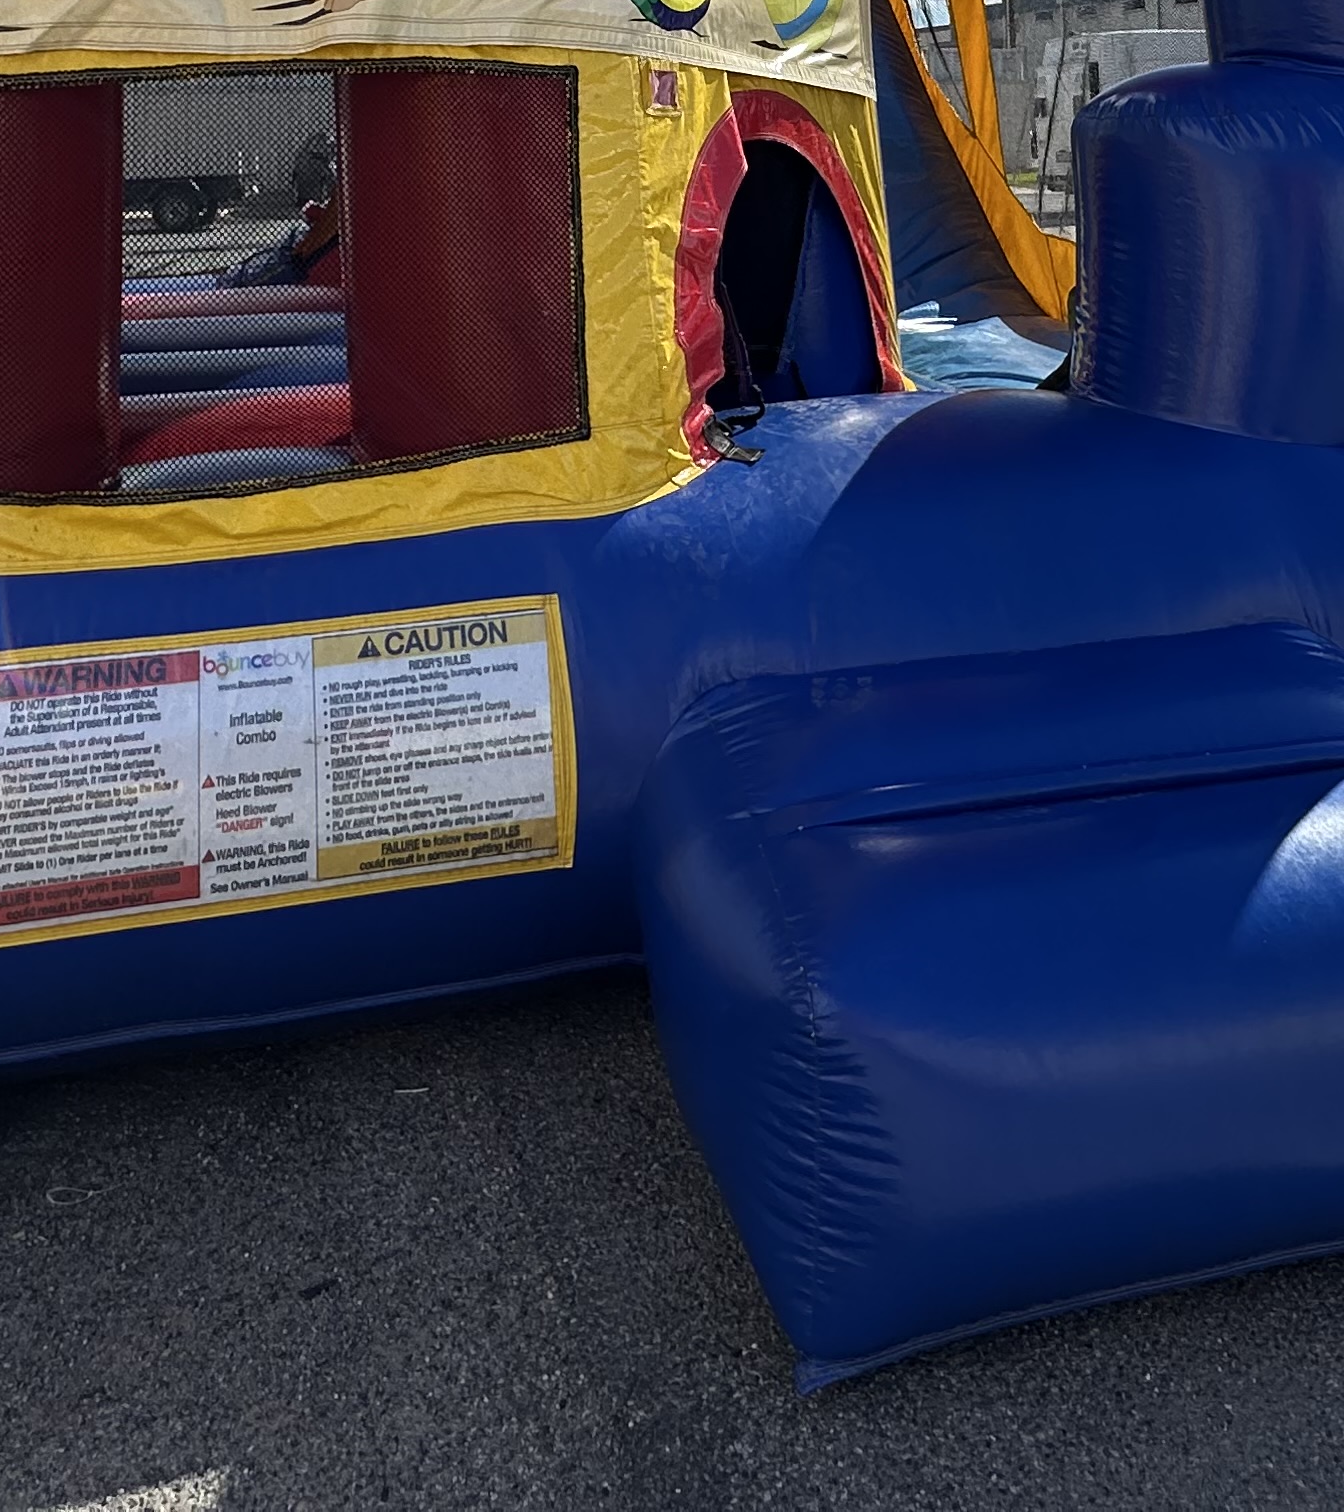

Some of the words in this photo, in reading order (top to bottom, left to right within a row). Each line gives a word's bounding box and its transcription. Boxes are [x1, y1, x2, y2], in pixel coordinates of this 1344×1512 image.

[384, 619, 508, 656] CAUTION
[203, 649, 310, 677] bouncebuy
[408, 656, 443, 671] RIDER'S
[444, 653, 471, 666] RULES
[23, 657, 166, 696] WARNING
[10, 700, 24, 712] DO
[27, 698, 46, 710] NOT
[47, 696, 81, 710] operate
[83, 693, 100, 705] this
[101, 691, 122, 703] Ride
[124, 687, 158, 700] without
[330, 693, 354, 706] NEVER
[373, 689, 387, 699] and
[388, 687, 404, 697] dive
[420, 684, 432, 694] the
[434, 682, 448, 692] ride
[4, 726, 29, 738] Adult
[30, 720, 75, 735] Attendant
[77, 716, 111, 732] present
[113, 715, 122, 726] at
[124, 713, 134, 725] all
[136, 711, 161, 723] times
[10, 713, 25, 724] the
[27, 707, 80, 725] Supervision
[82, 705, 91, 717] of
[93, 705, 99, 715] a
[230, 708, 283, 728] Inflatable
[236, 729, 277, 745] Combo
[2, 773, 17, 784] The
[89, 764, 102, 774] the
[104, 762, 121, 772] Ride
[216, 775, 236, 787] This
[238, 772, 260, 785] Ride
[262, 768, 302, 782] requires
[4, 799, 21, 810] NOT
[23, 797, 45, 808] allow
[47, 794, 73, 807] people
[75, 793, 84, 802] or
[86, 789, 111, 800] Riders
[113, 788, 121, 797] to
[123, 786, 137, 796] Use
[139, 784, 152, 794] the
[154, 781, 171, 792] Ride
[216, 786, 252, 802] electric
[253, 783, 293, 797] Blowers
[332, 793, 354, 806] SLIDE
[356, 790, 379, 803] DOWN
[381, 788, 395, 798] feet
[396, 786, 411, 796] first
[413, 783, 428, 794] only
[379, 803, 388, 812] up
[390, 800, 402, 810] the
[403, 797, 421, 808] slide
[447, 793, 463, 802] way
[9, 807, 52, 820] consumed
[54, 802, 83, 814] alcohol
[84, 803, 93, 811] or
[115, 796, 138, 807] drugs
[14, 820, 46, 833] RIDER'S
[48, 821, 58, 831] by
[60, 815, 107, 828] comparable
[109, 810, 136, 822] weight
[138, 807, 153, 818] and
[216, 805, 241, 820] Heed
[243, 803, 277, 817] Blower
[270, 812, 294, 828] sign!
[19, 834, 48, 846] exceed
[49, 833, 62, 842] the
[64, 828, 105, 840] Maximum
[107, 824, 138, 835] number
[139, 821, 148, 831] of
[149, 818, 175, 829] Riders
[176, 818, 185, 827] or
[381, 838, 420, 856] FAILURE
[422, 838, 431, 848] to
[433, 835, 462, 847] follow
[463, 831, 488, 842] these
[490, 824, 521, 841] RULES
[14, 861, 34, 872] Slide
[36, 859, 44, 869] to
[46, 857, 57, 870] (1)
[58, 856, 75, 866] One
[77, 852, 97, 864] Rider
[99, 851, 113, 863] per
[114, 849, 131, 859] lane
[133, 846, 142, 857] at
[143, 847, 149, 855] a
[150, 844, 168, 854] time
[216, 843, 267, 861] WARNING,
[268, 842, 286, 853] this
[288, 839, 310, 850] Ride
[360, 857, 386, 871] could
[388, 854, 414, 867] result
[416, 853, 426, 862] in
[427, 848, 469, 861] someone
[471, 842, 503, 858] getting
[505, 837, 533, 851] HURT!
[216, 862, 242, 874] must
[243, 859, 256, 871] be
[257, 851, 307, 869] Anchored!
[210, 882, 229, 894] See
[230, 877, 270, 892] Owner's
[272, 870, 309, 886] Manual
